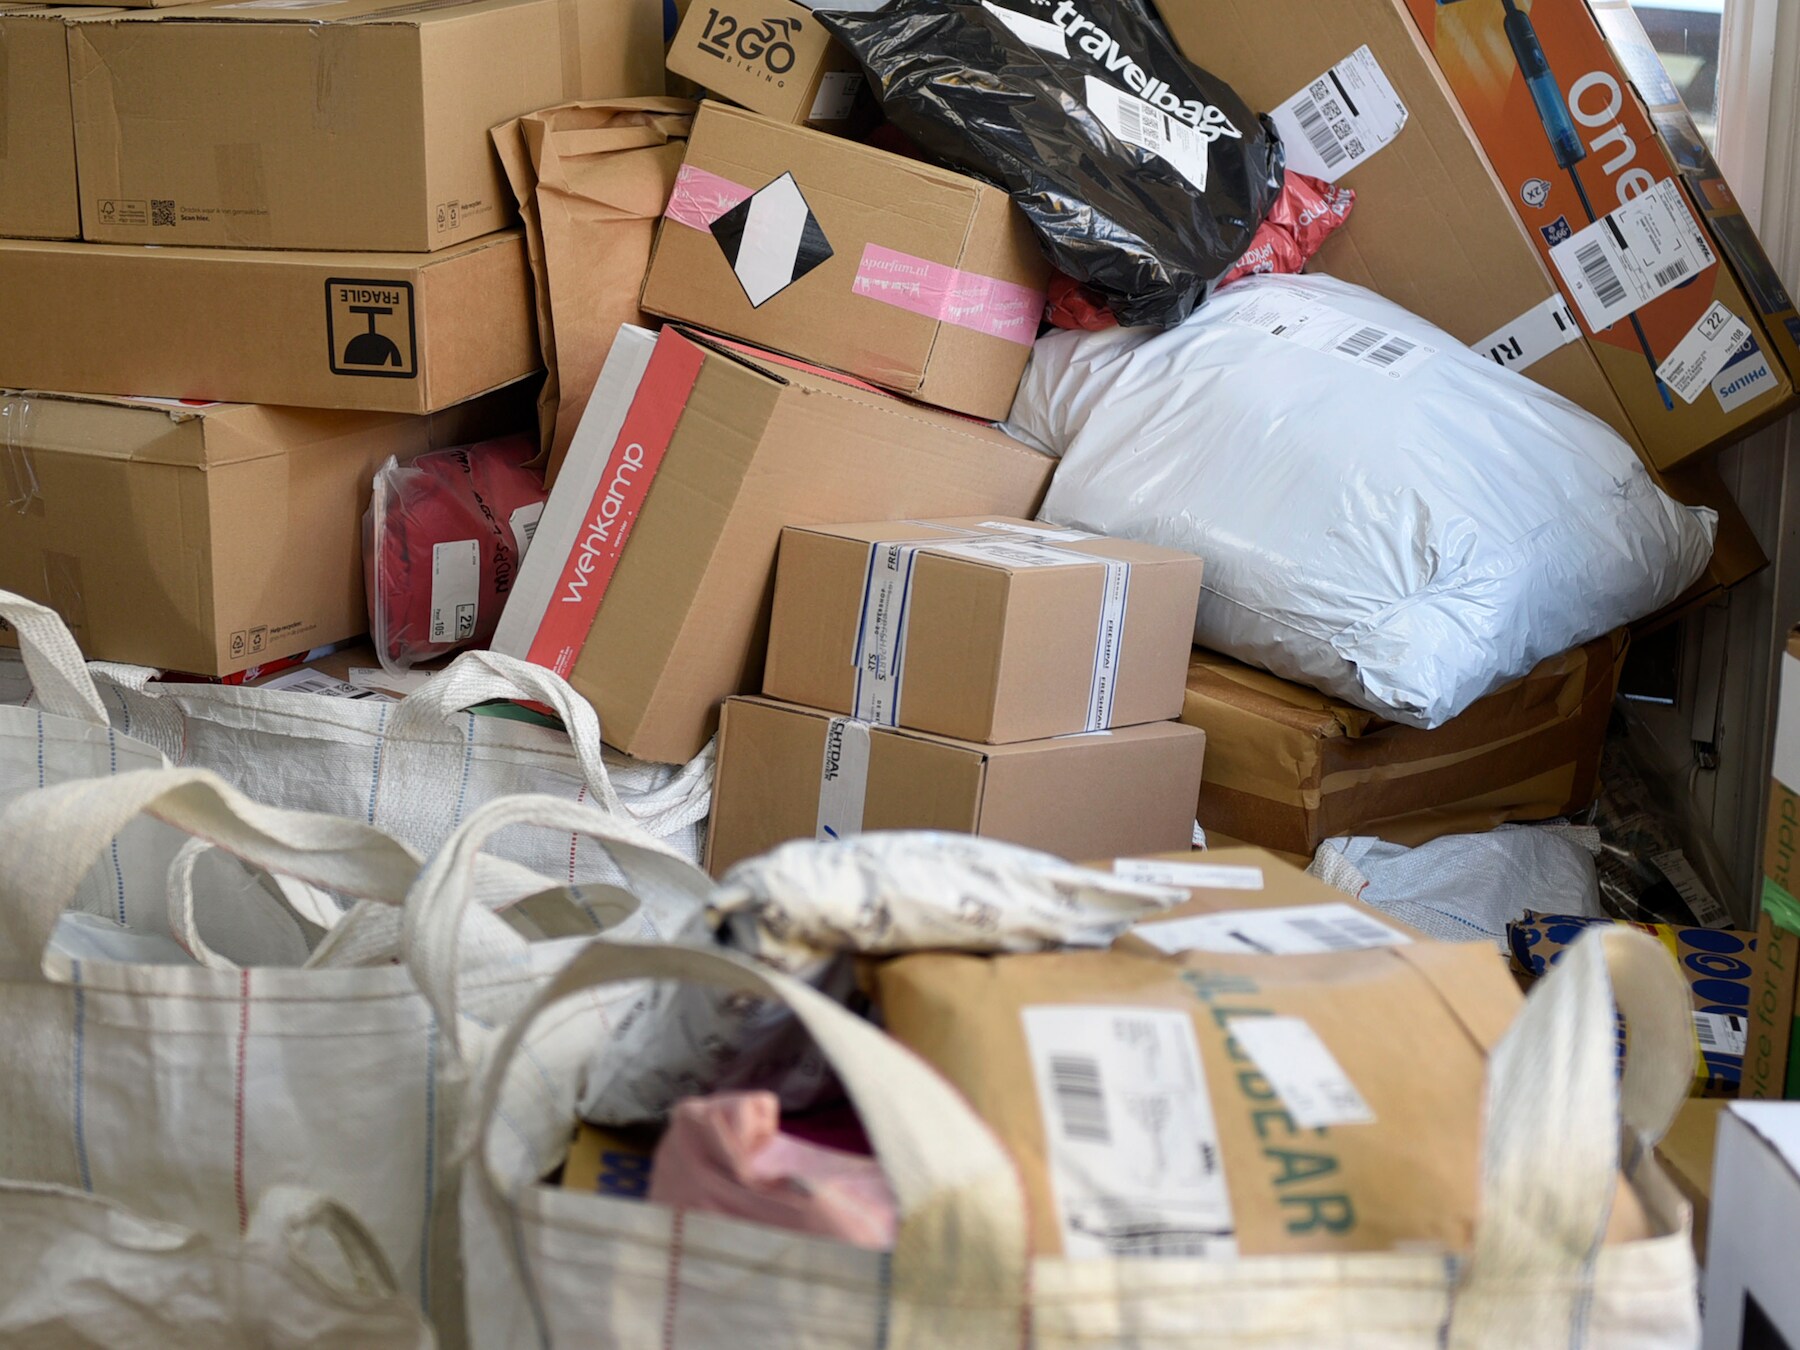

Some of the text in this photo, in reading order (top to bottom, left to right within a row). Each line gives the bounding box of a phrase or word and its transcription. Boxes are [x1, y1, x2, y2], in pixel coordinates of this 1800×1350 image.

[702, 8, 795, 74] 12GO
[726, 55, 785, 88] BIKING
[180, 214, 195, 222] Scan
[340, 289, 400, 305] FRAGILE
[1706, 312, 1724, 330] 22
[1730, 328, 1744, 343] 108
[1719, 366, 1767, 398] PHILIPS
[562, 442, 644, 603] wehkamp
[435, 621, 445, 636] 105
[460, 614, 472, 632] 22
[1756, 977, 1779, 1029] for
